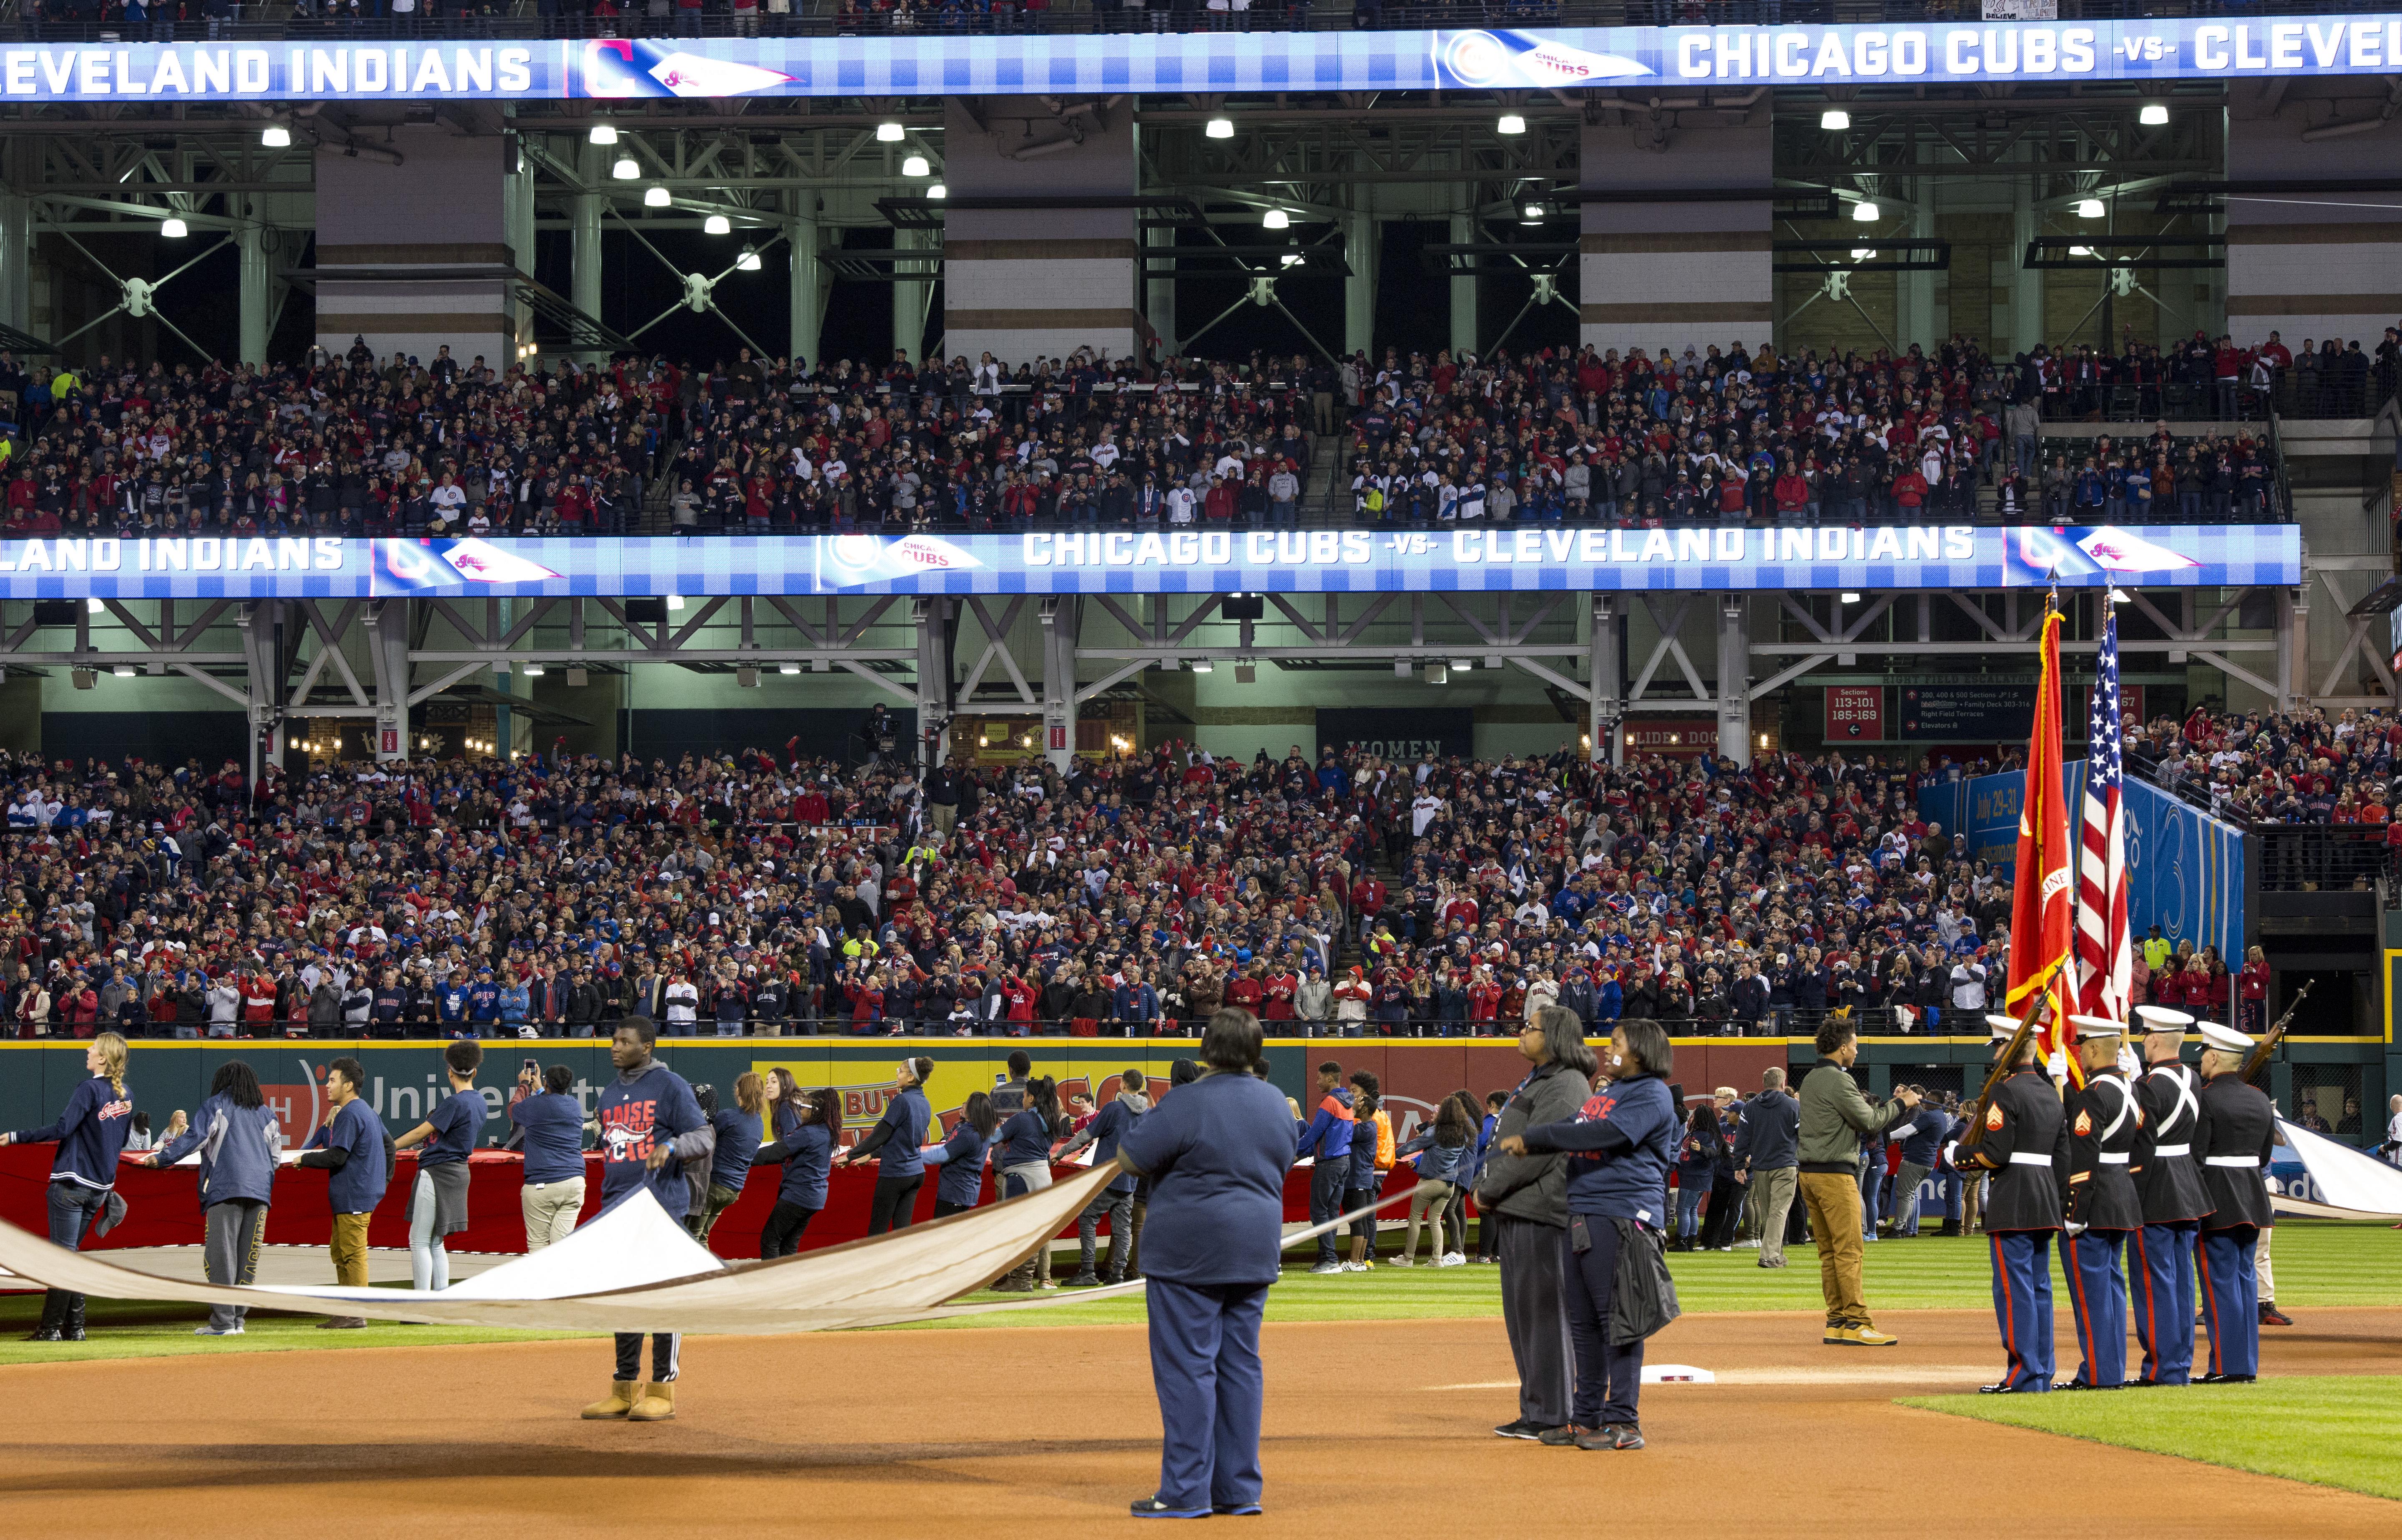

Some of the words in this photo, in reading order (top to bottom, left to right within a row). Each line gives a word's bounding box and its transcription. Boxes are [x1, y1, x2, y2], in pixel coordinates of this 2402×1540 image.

[1678, 31, 1927, 78] CHICAGO
[1945, 28, 2095, 75] CUBS
[0, 49, 271, 95] EVELAND
[292, 48, 531, 93] INDIANS
[903, 542, 935, 553] CHICA
[1024, 533, 1231, 566] CHICAGO
[1247, 532, 1372, 565] CUBS
[1453, 528, 1745, 564] CLEVELAND
[1764, 527, 1975, 562] INDIANS
[139, 538, 343, 571] INDIANS
[901, 549, 950, 567] CUBS
[1835, 698, 1874, 707] 113-101
[1832, 710, 1877, 720] 185-169
[1629, 731, 1683, 744] LIDER
[1976, 792, 1990, 825] July
[1992, 788, 2017, 818] 29-31
[2309, 802, 2331, 811] INDIANS
[2042, 872, 2065, 900] RINE
[476, 991, 495, 1000] CUBS
[1268, 985, 1291, 995] IDIANS
[1532, 987, 1546, 996] INDI
[378, 998, 399, 1007] INDIANS
[603, 1100, 657, 1131] RAISE
[613, 1141, 626, 1160] C
